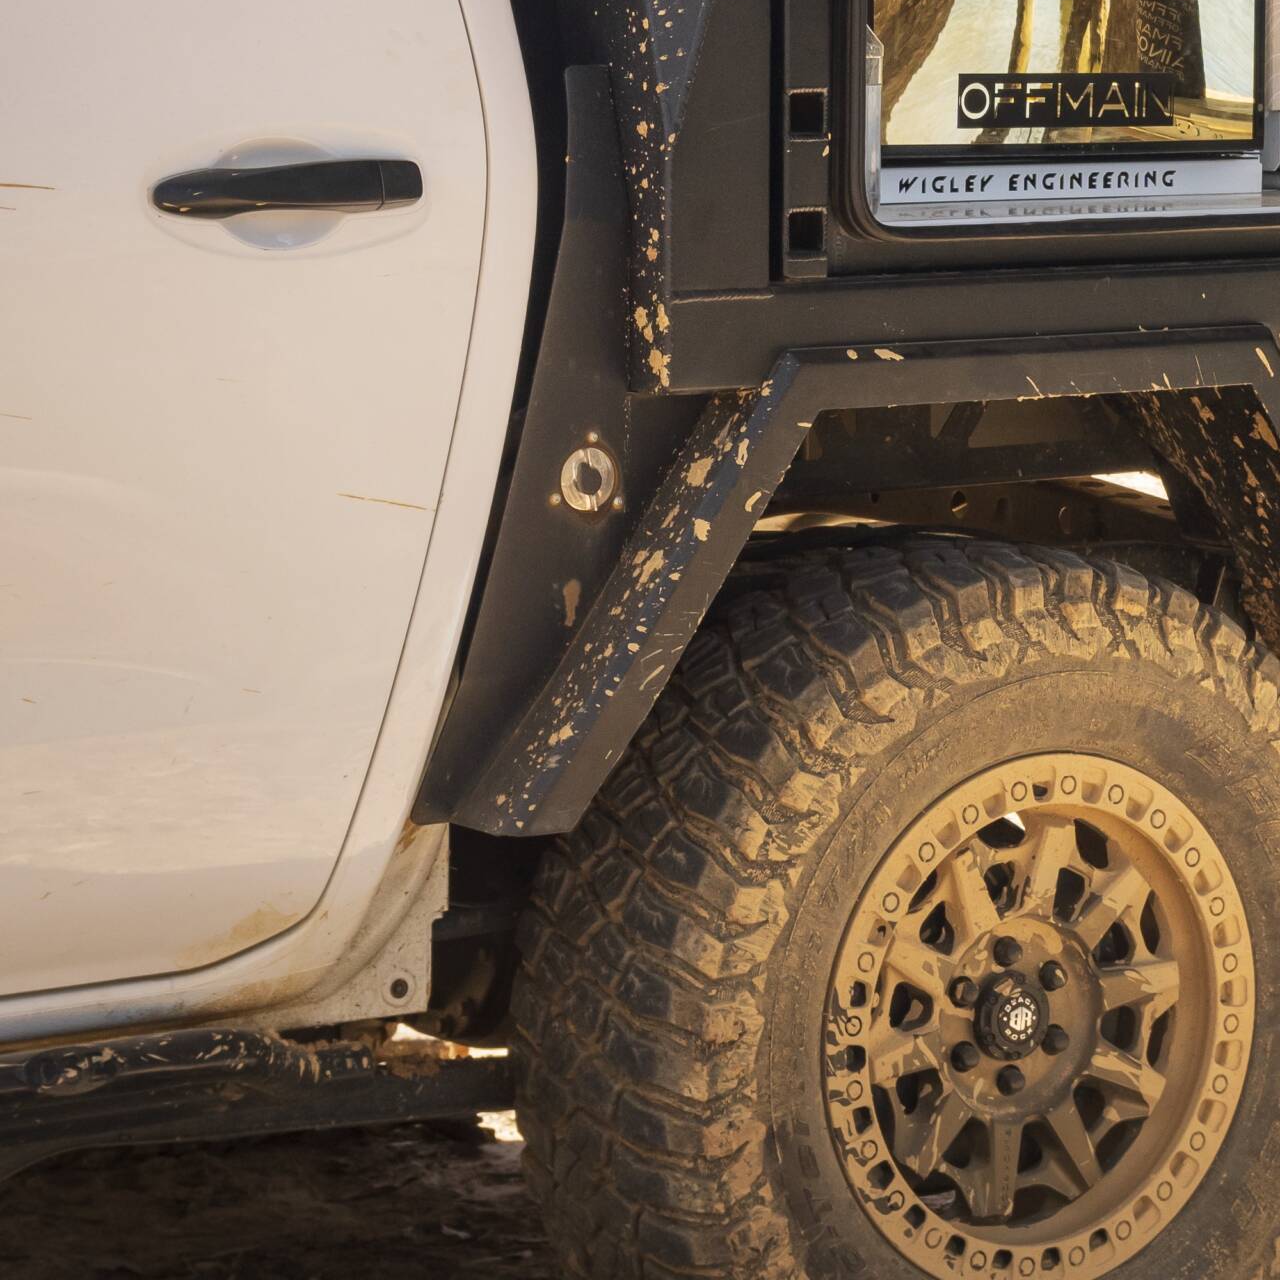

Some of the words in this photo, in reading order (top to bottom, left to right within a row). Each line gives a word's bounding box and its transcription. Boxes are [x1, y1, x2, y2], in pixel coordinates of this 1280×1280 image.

[959, 81, 1173, 120] OFFMAIN
[898, 174, 995, 194] WIGLEY
[1008, 170, 1177, 192] ENGINEERING
